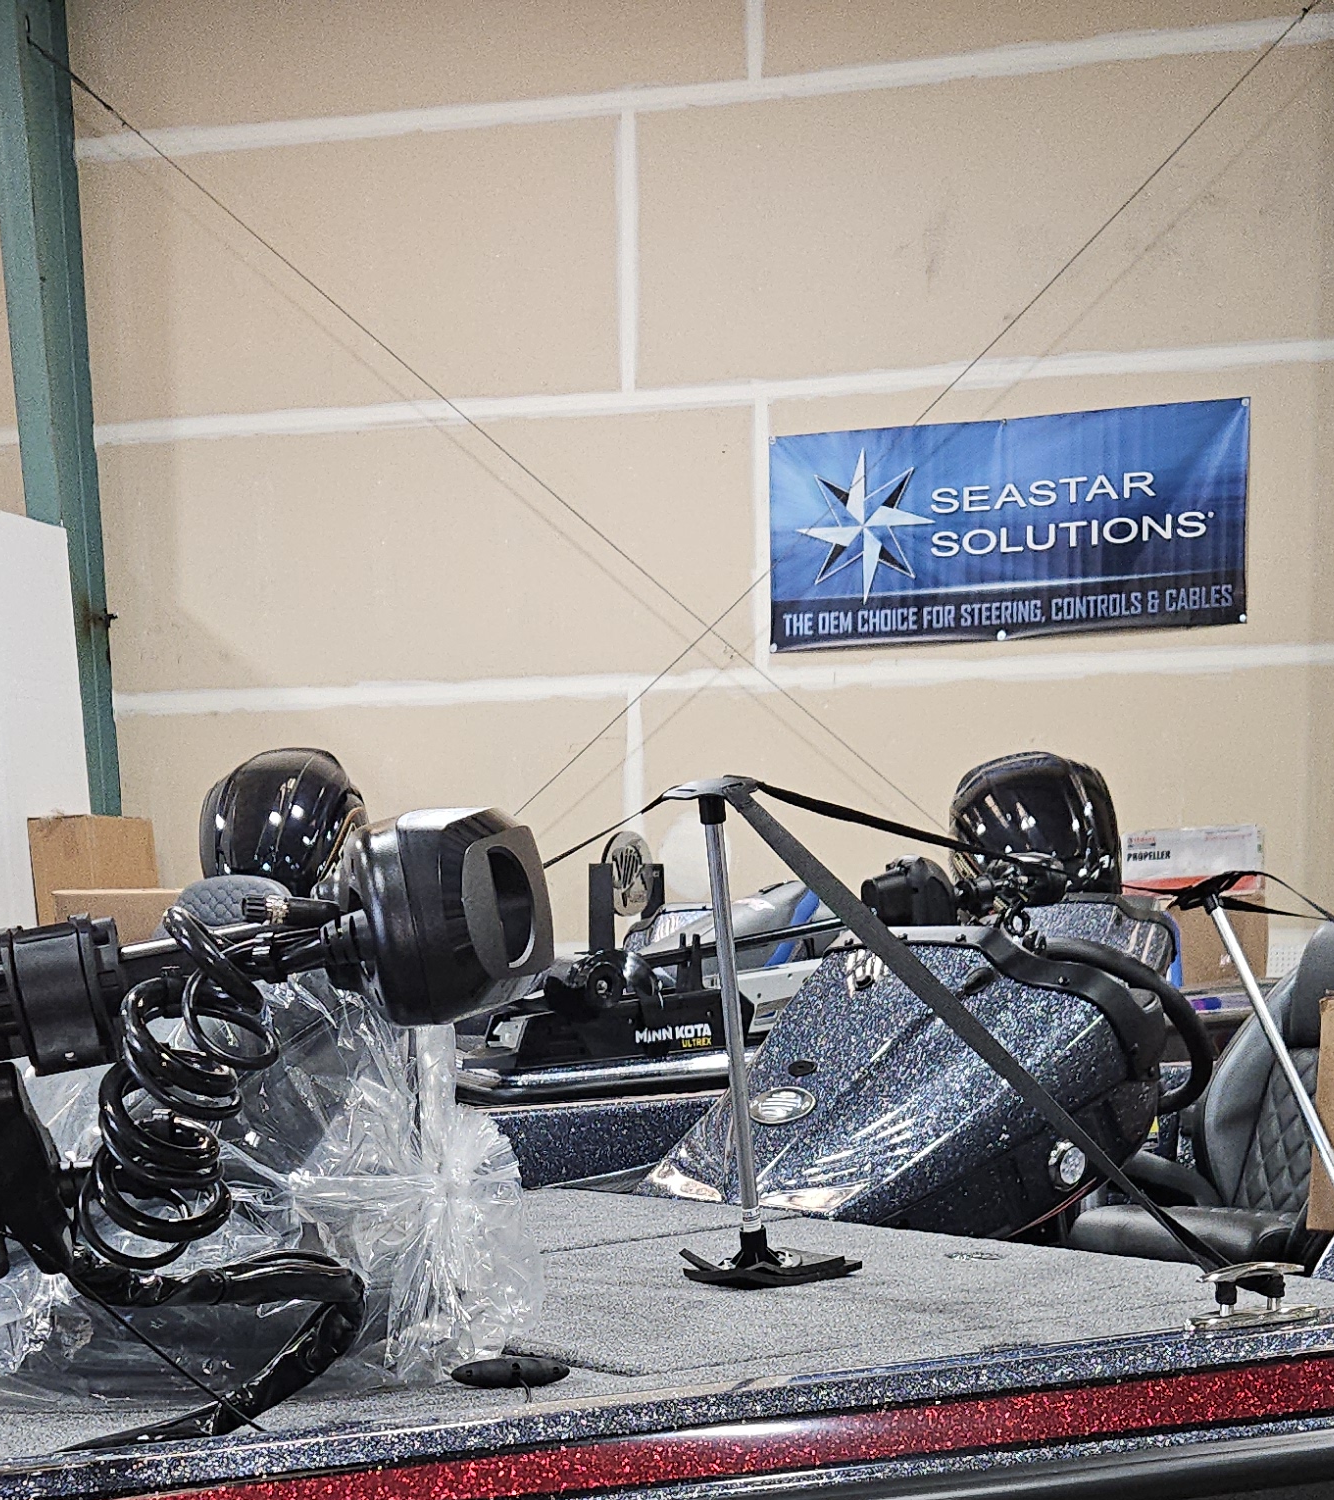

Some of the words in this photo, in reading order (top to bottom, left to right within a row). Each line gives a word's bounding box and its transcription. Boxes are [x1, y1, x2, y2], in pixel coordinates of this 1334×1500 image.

[930, 471, 1156, 514] SEASTAR
[930, 510, 1209, 558] SOLUTIONS
[783, 612, 814, 637] THE
[818, 611, 853, 634] OEM
[857, 606, 918, 632] CHOICE
[923, 605, 955, 629] FOR
[960, 601, 1047, 629] STEERING,
[1051, 593, 1142, 621] CONTROLS
[1147, 594, 1160, 614] &
[1165, 584, 1234, 610] CABLES
[1127, 850, 1171, 862] PROPELLER
[635, 1025, 673, 1044] MINN
[674, 1023, 712, 1040] KOTA
[681, 1037, 712, 1048] ULTREX
